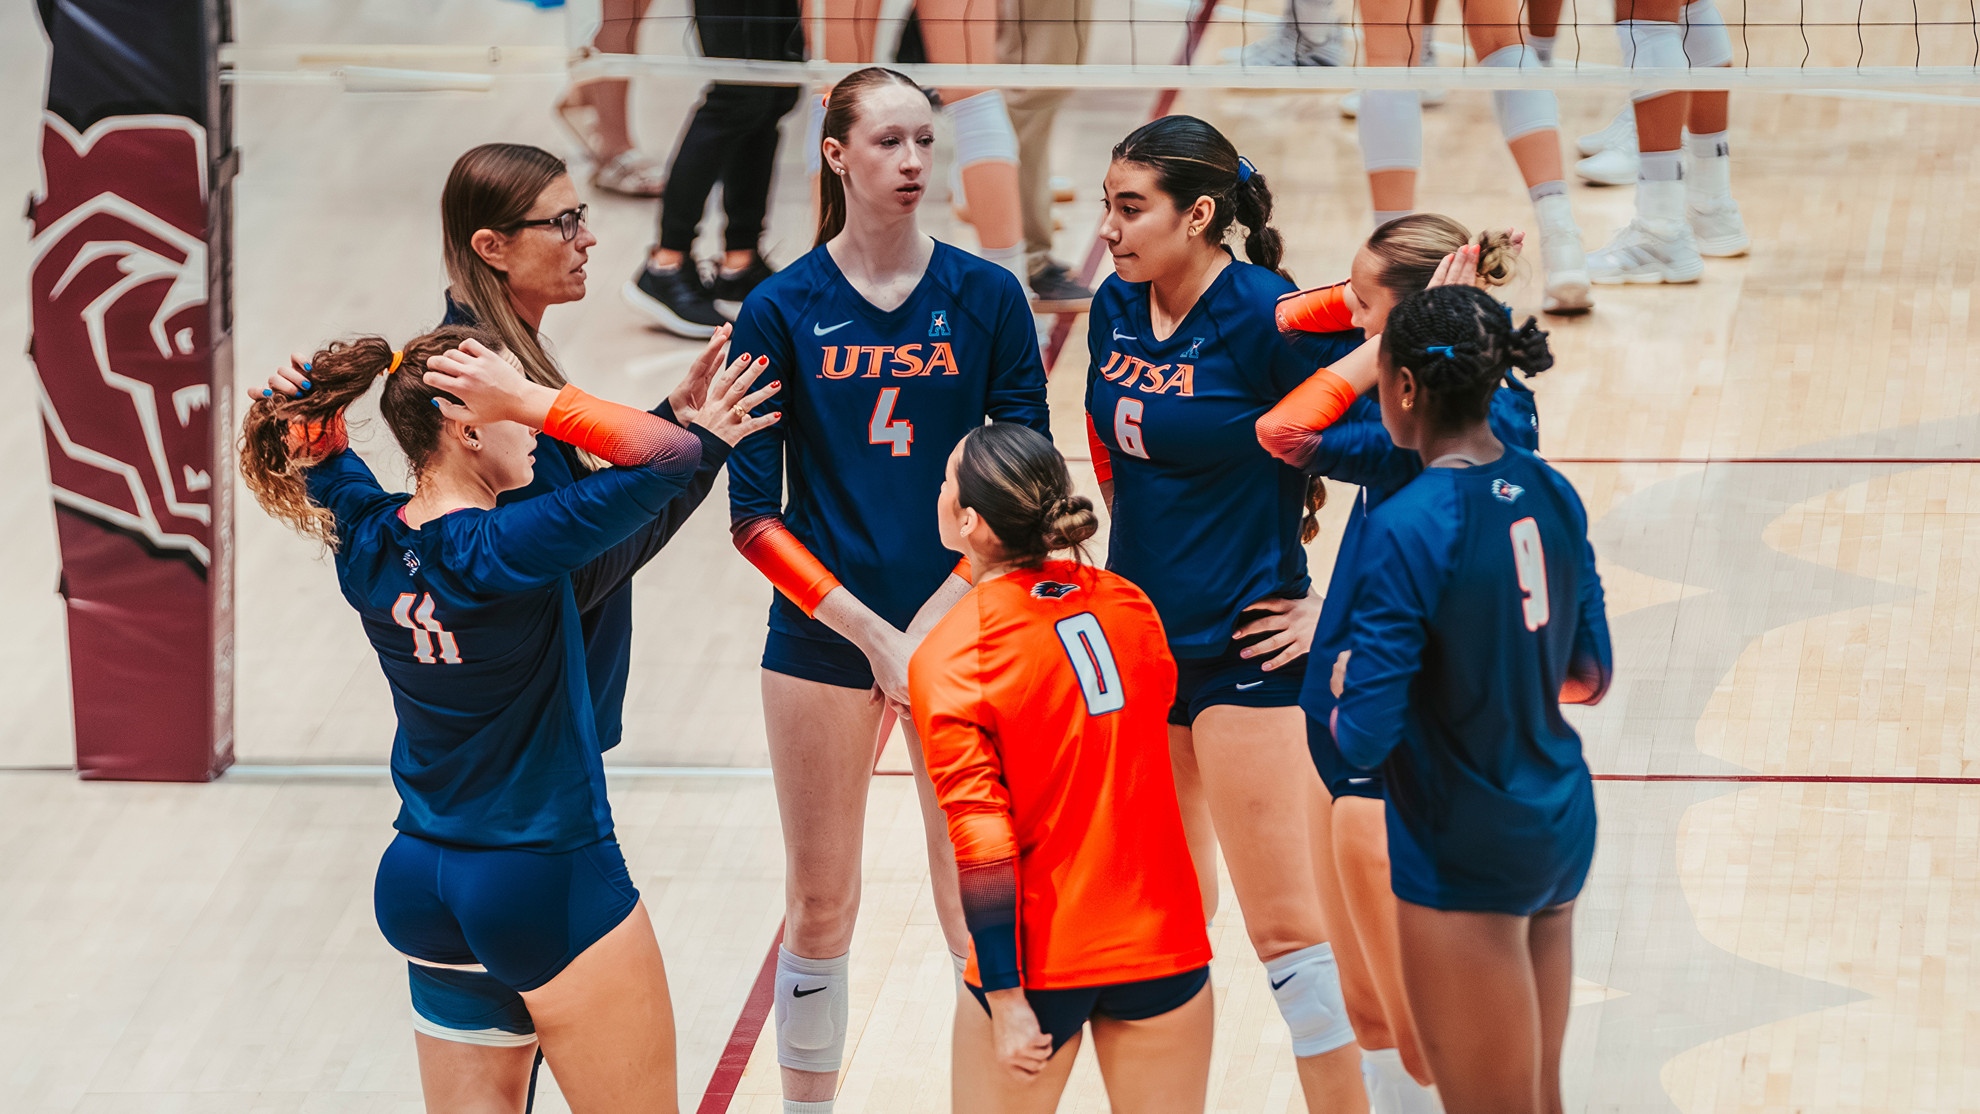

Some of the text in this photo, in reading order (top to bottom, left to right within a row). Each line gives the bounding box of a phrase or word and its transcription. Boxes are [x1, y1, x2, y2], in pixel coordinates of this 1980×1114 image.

[821, 342, 960, 379] UTSA
[1100, 351, 1194, 397] UTSA
[869, 387, 913, 456] 4
[1114, 397, 1150, 459] 6
[1510, 516, 1549, 632] 9
[392, 592, 463, 664] 11
[1054, 611, 1125, 716] 0
